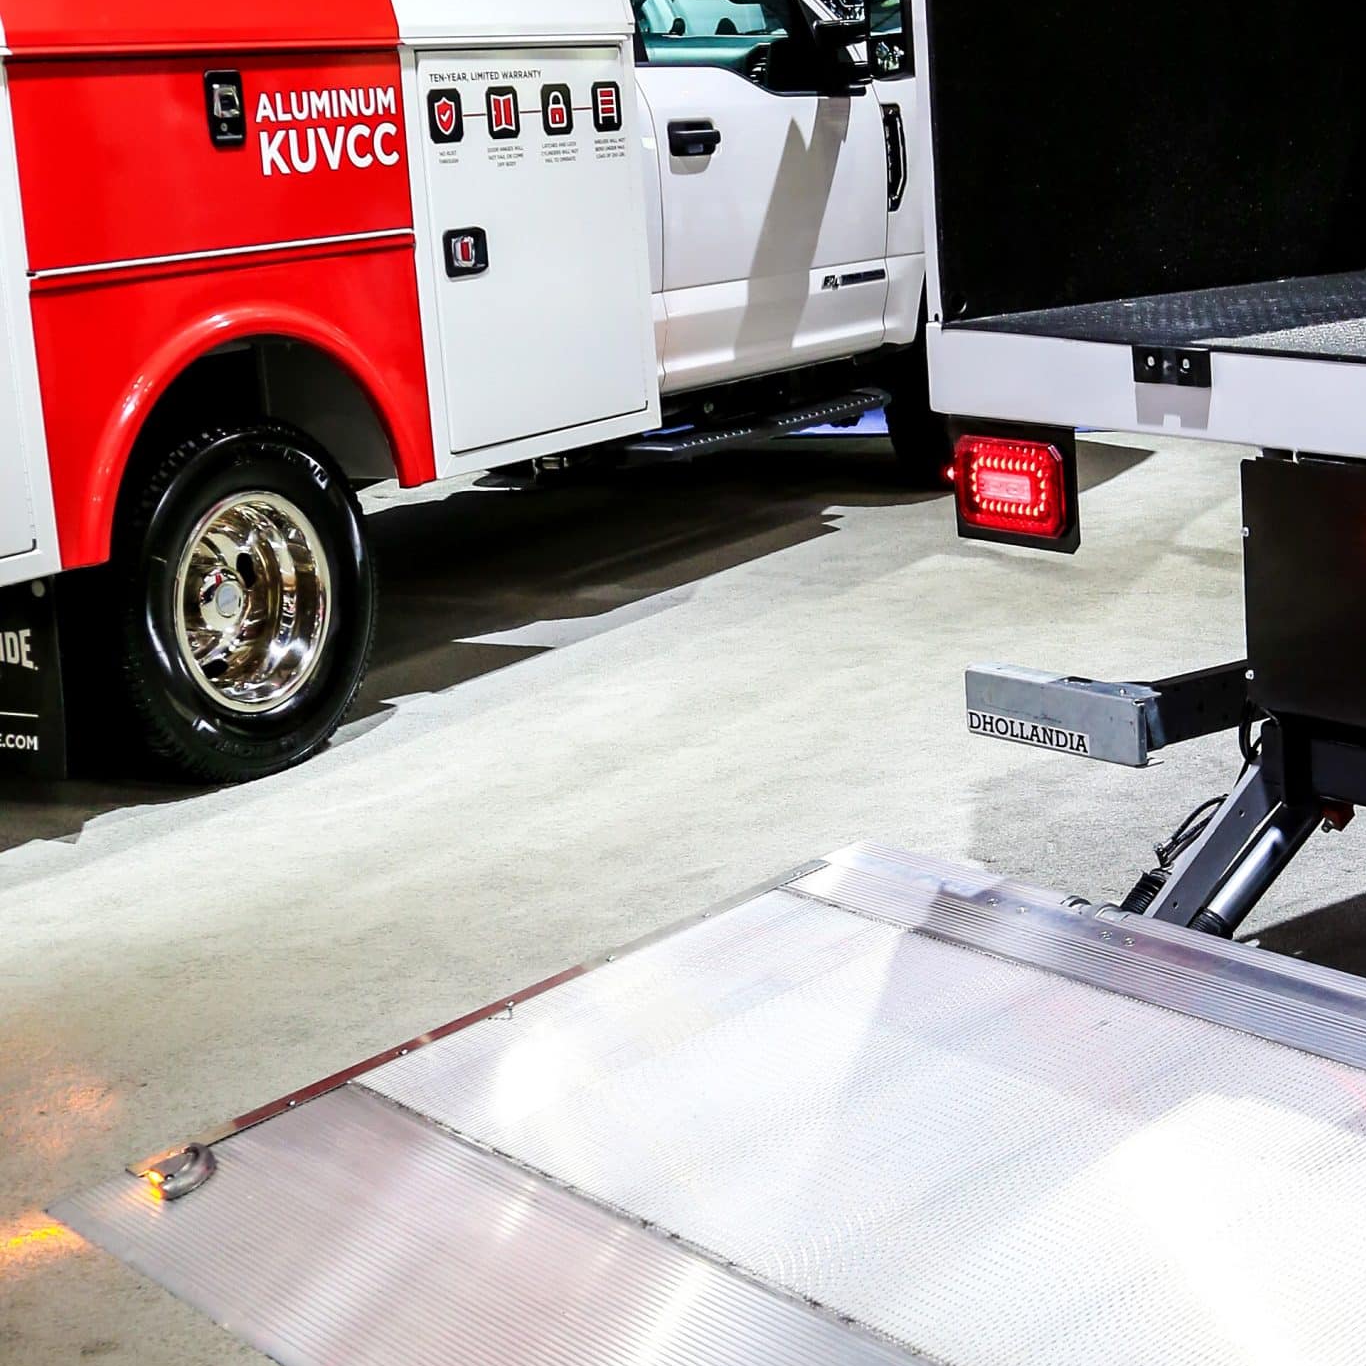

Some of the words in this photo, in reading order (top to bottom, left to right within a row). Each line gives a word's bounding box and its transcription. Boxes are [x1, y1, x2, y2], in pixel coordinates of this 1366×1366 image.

[428, 72, 470, 83] TEN-YEAR,
[470, 71, 499, 81] LIMITED
[501, 69, 542, 80] WARRANTY
[255, 87, 397, 123] ALUMINUM
[259, 122, 400, 176] KUVCC
[968, 711, 1089, 754] DHOLLANDIA
